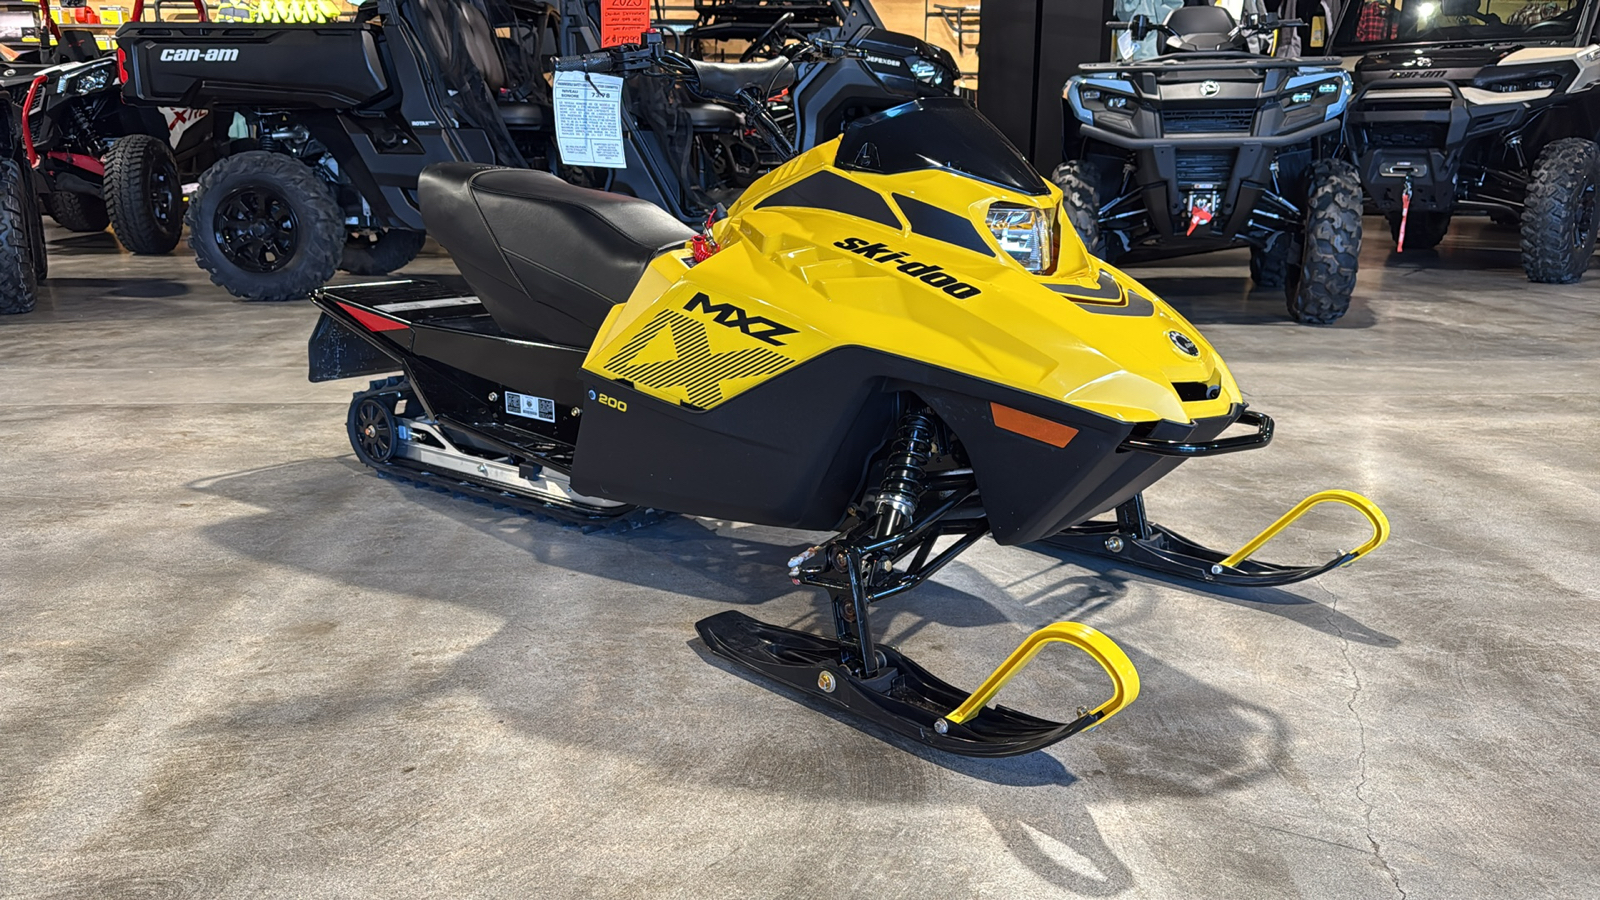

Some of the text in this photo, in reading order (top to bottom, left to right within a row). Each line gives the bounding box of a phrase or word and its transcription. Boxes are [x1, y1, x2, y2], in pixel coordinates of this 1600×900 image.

[160, 48, 239, 62] can-am
[866, 55, 901, 67] DEFENDER
[833, 237, 982, 300] ski-doo
[682, 291, 801, 347] MXZ
[598, 393, 628, 412] 200
